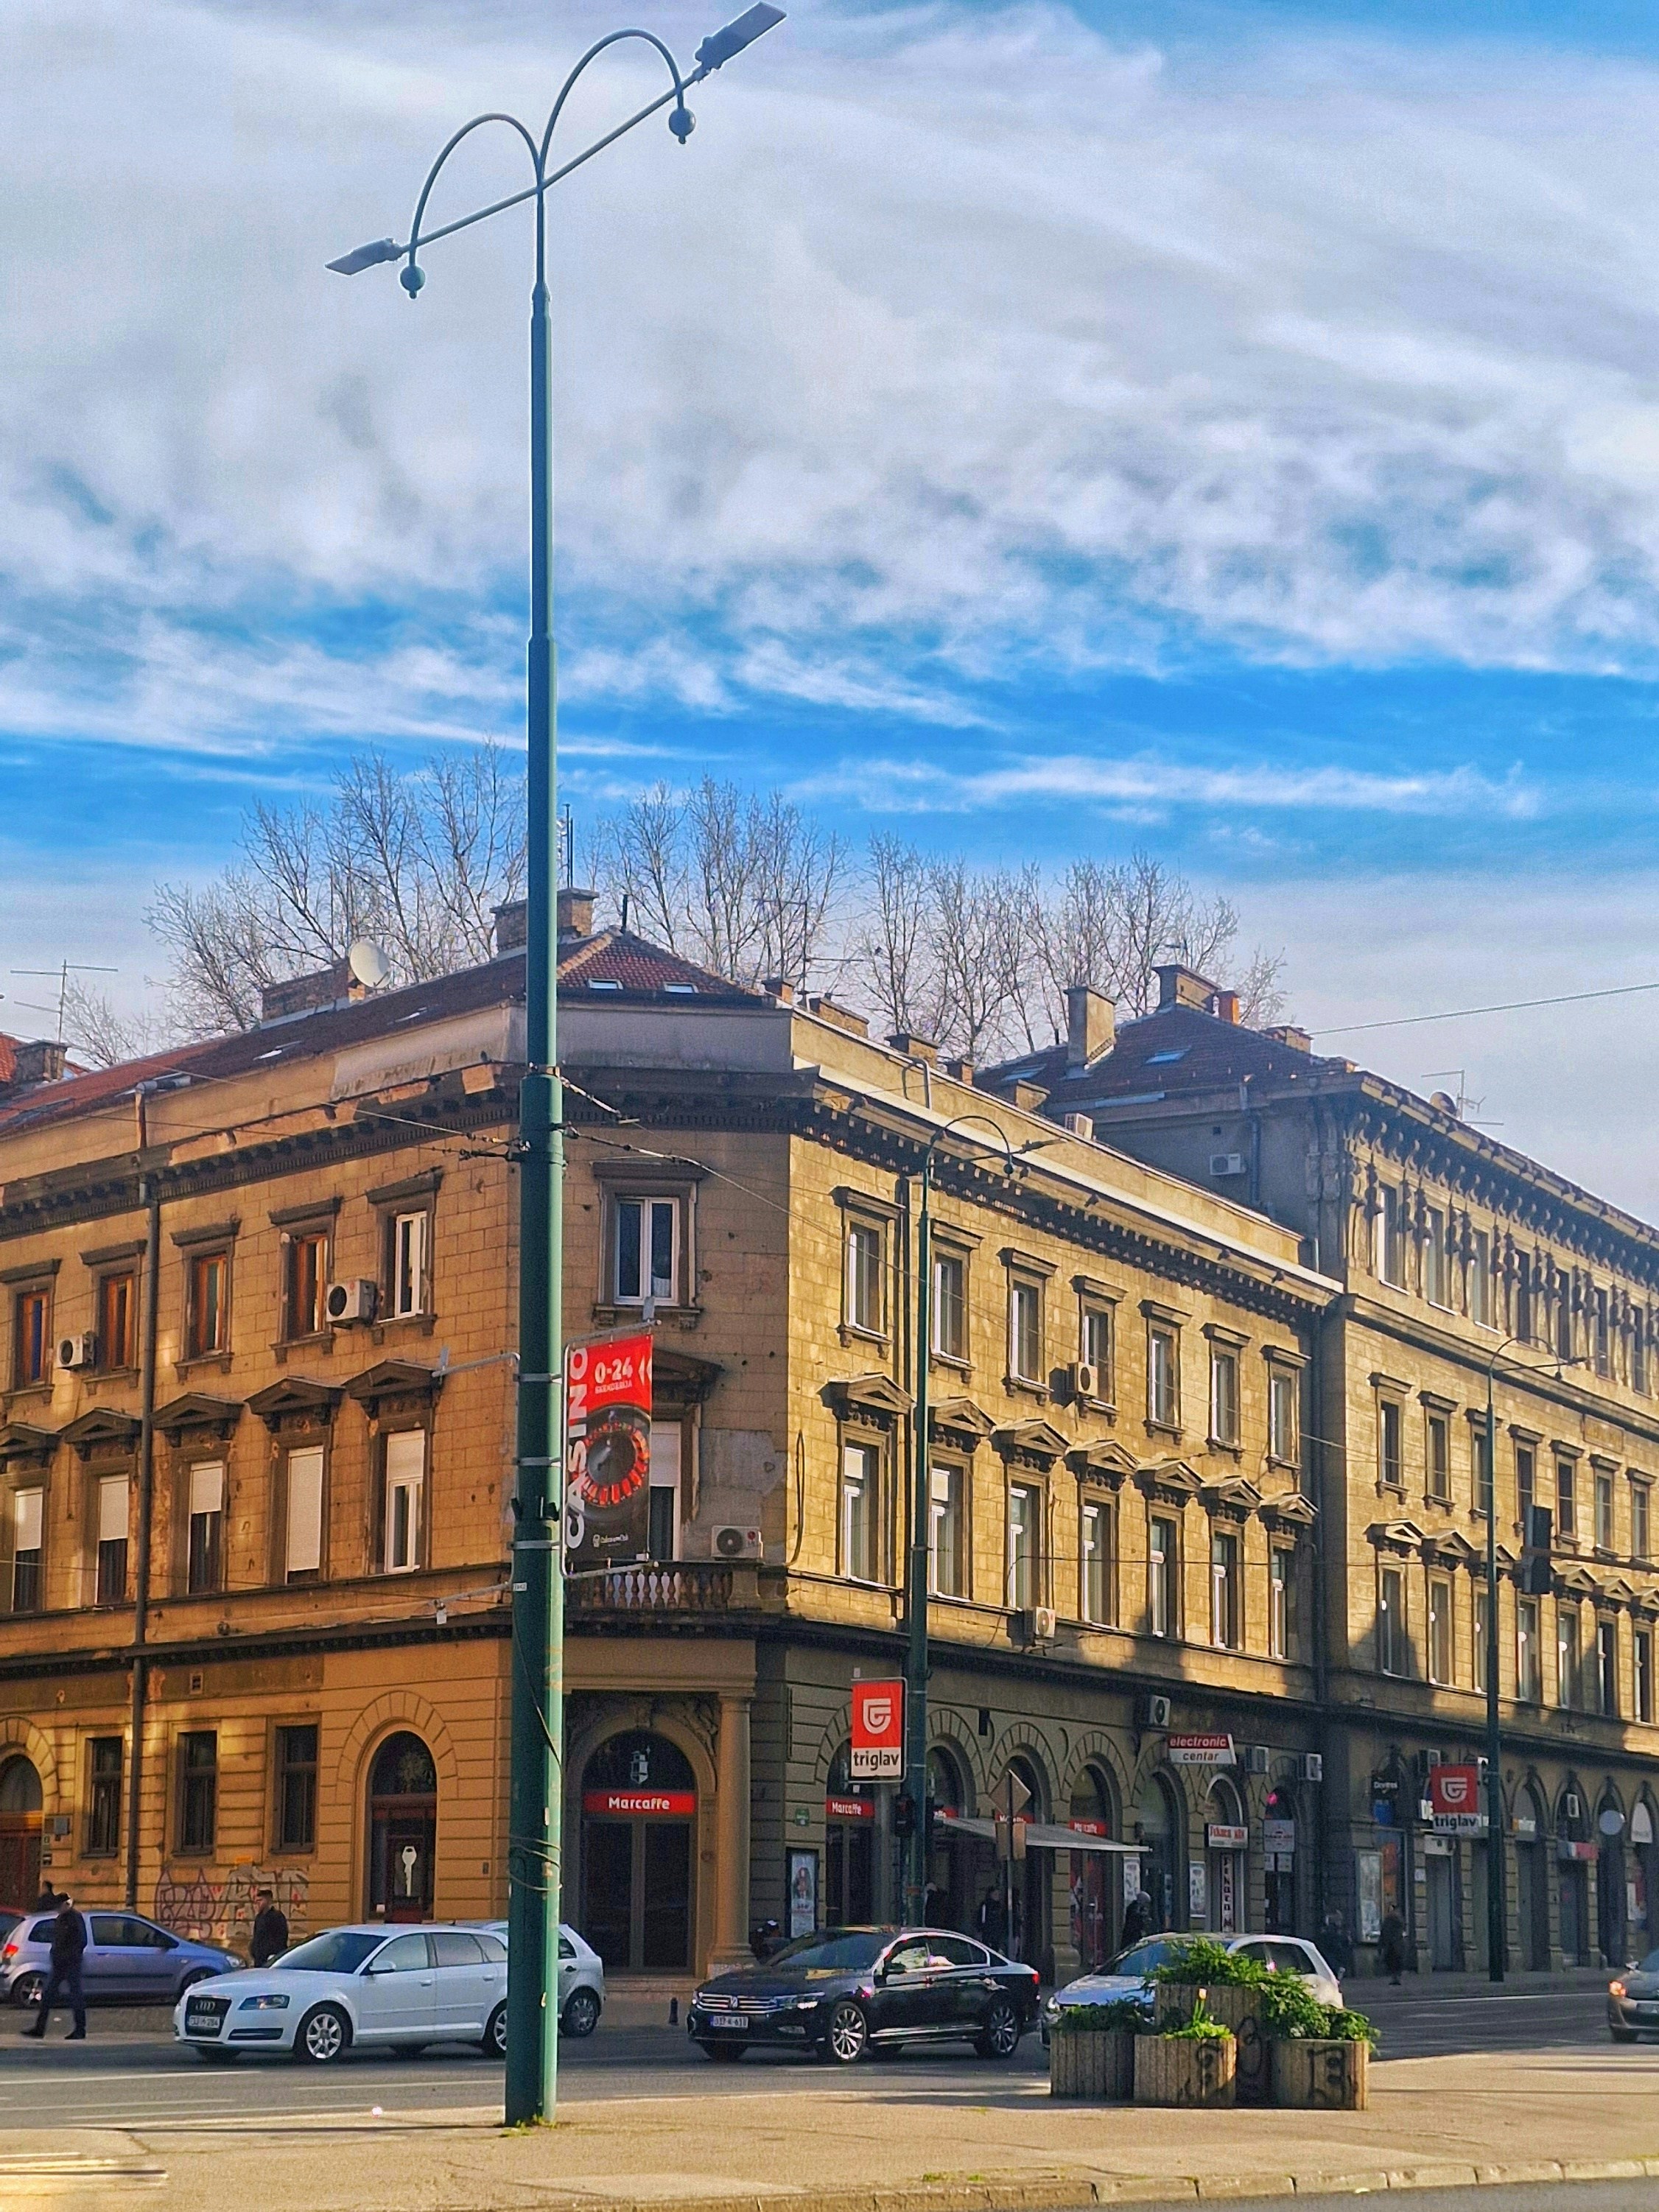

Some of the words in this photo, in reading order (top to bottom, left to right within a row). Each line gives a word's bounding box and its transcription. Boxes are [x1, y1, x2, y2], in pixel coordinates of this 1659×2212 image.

[594, 1356, 634, 1384] 0-24
[567, 1348, 589, 1549] CASINO
[1170, 1736, 1227, 1747] electronic
[853, 1750, 899, 1772] triglav
[1182, 1752, 1219, 1761] centar
[608, 1797, 670, 1810] Marcaffe
[832, 1802, 862, 1815] Marcaffe
[1434, 1814, 1478, 1830] triglav
